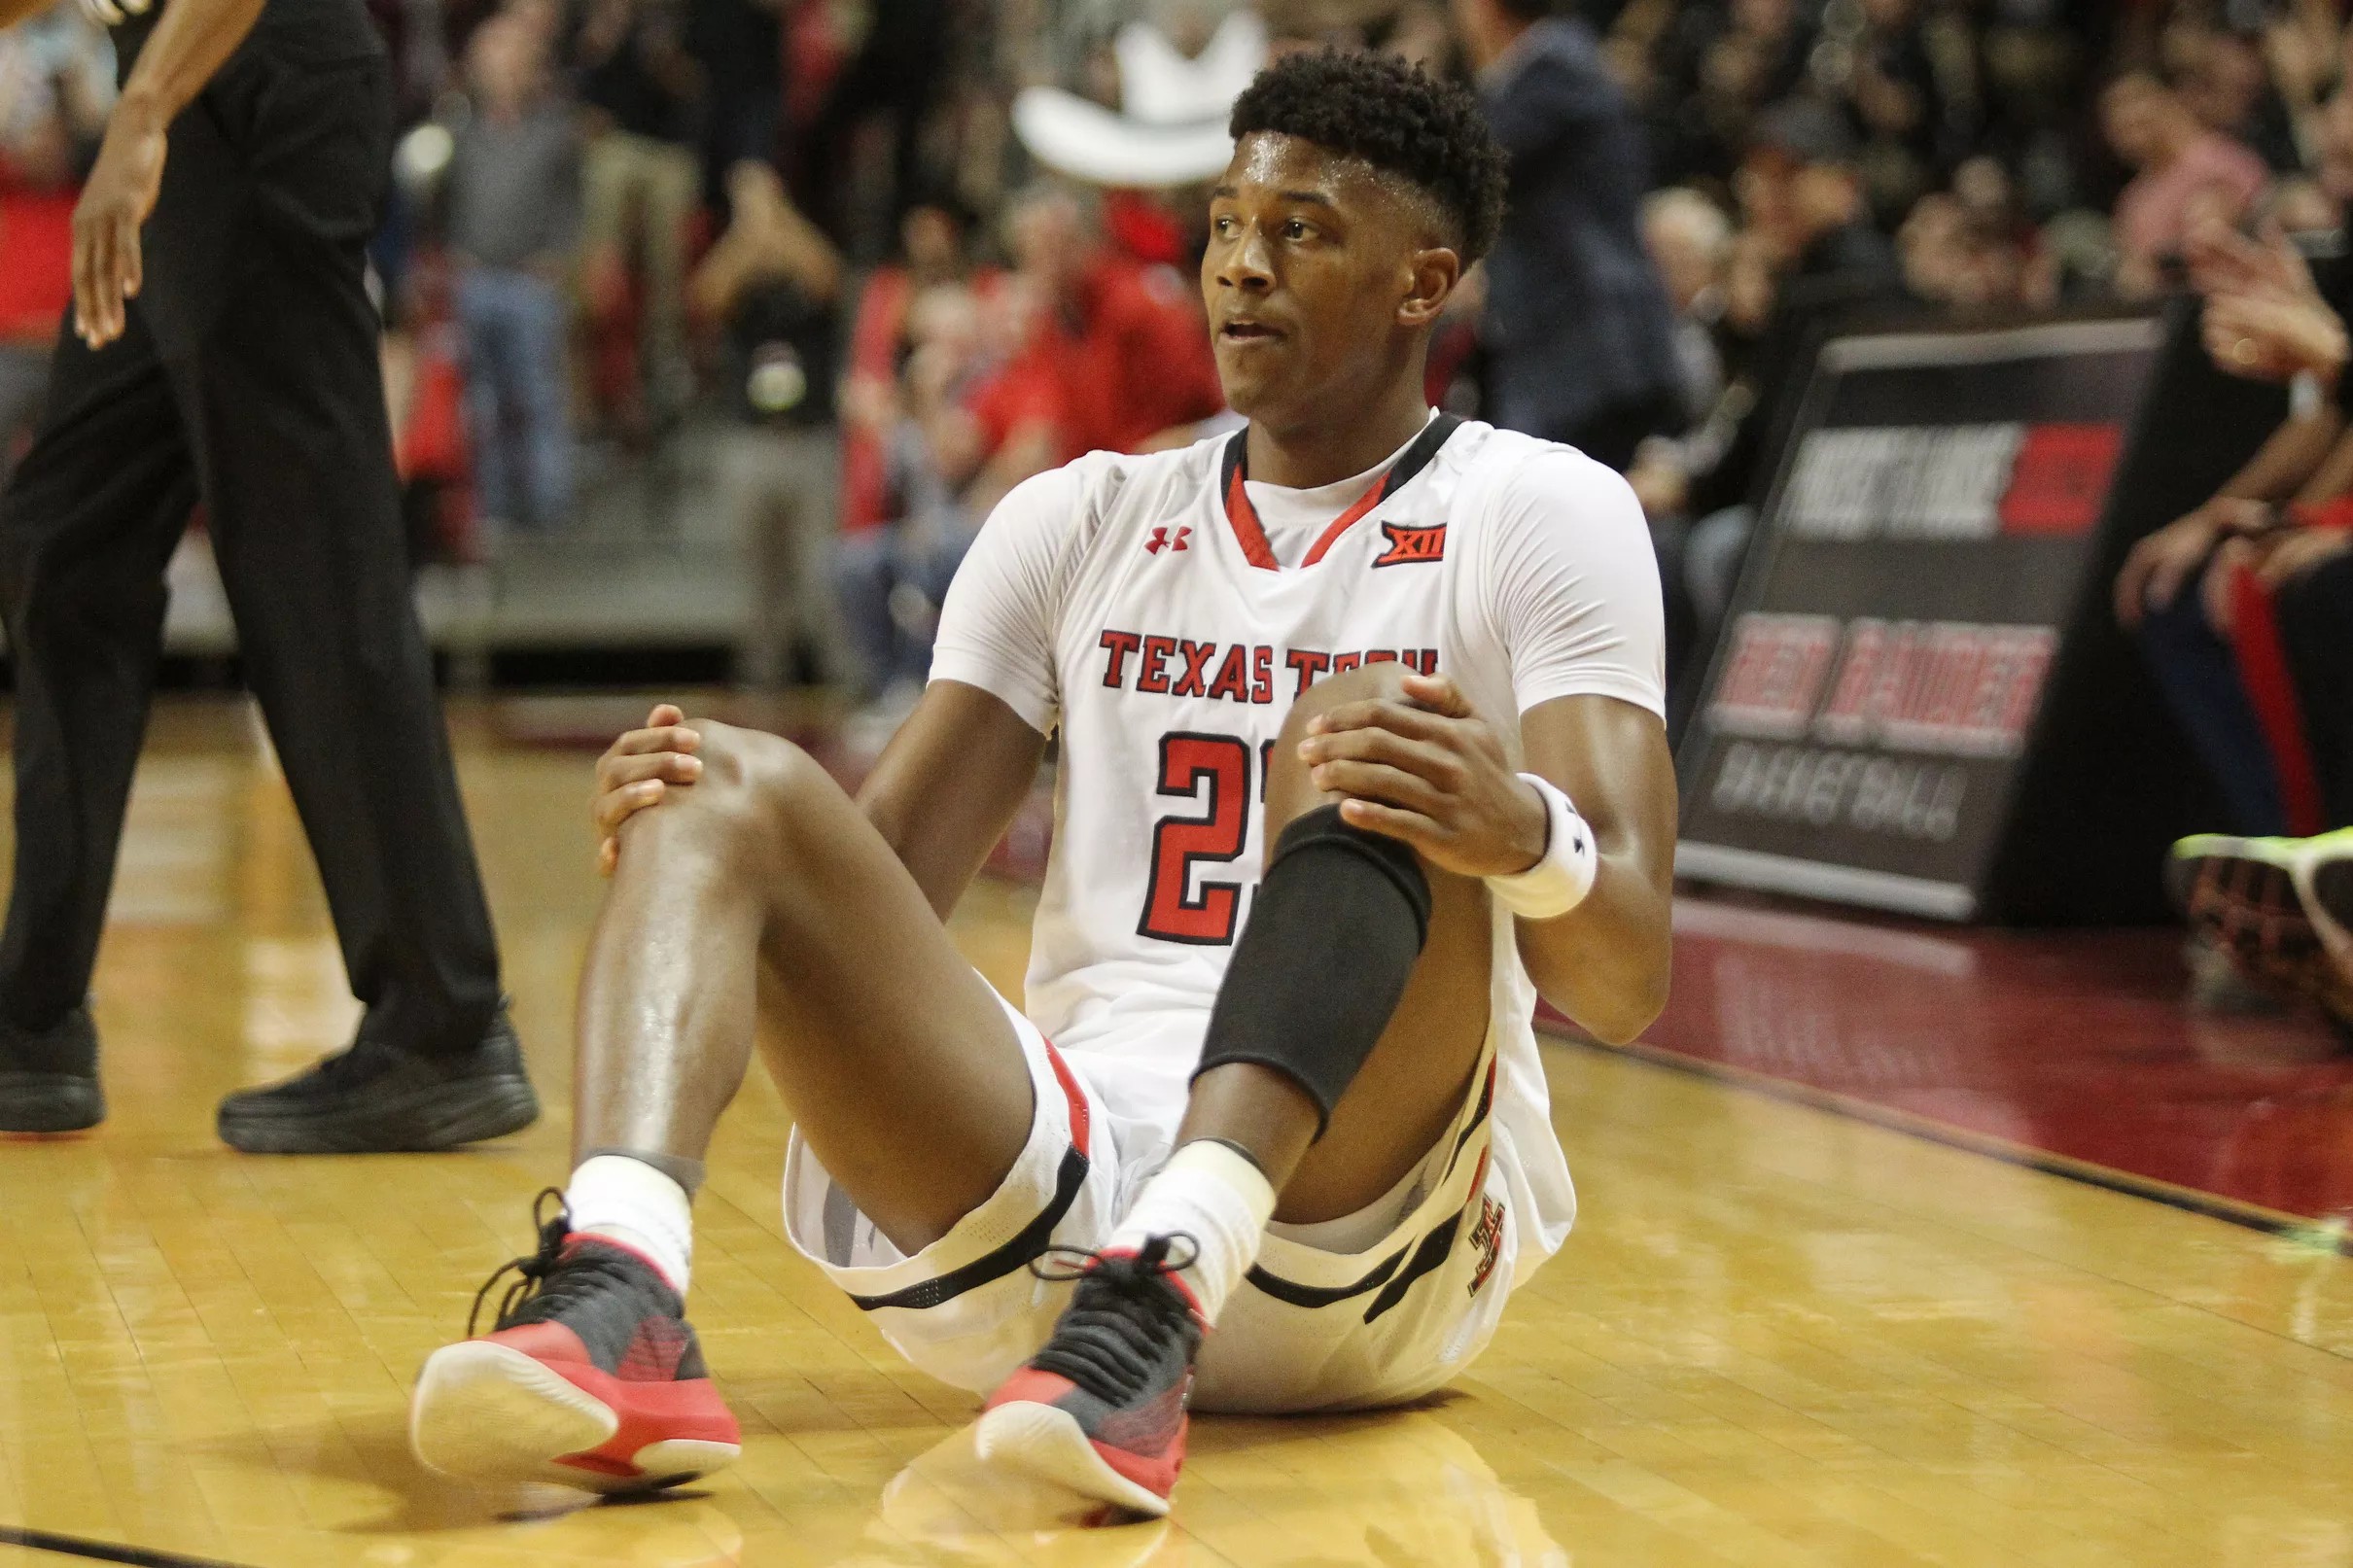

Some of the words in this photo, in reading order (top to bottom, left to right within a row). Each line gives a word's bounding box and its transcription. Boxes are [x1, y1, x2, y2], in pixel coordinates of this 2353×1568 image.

[1371, 520, 1448, 570] XII
[1099, 630, 1273, 704] TEXAS
[1136, 731, 1278, 946] 2
